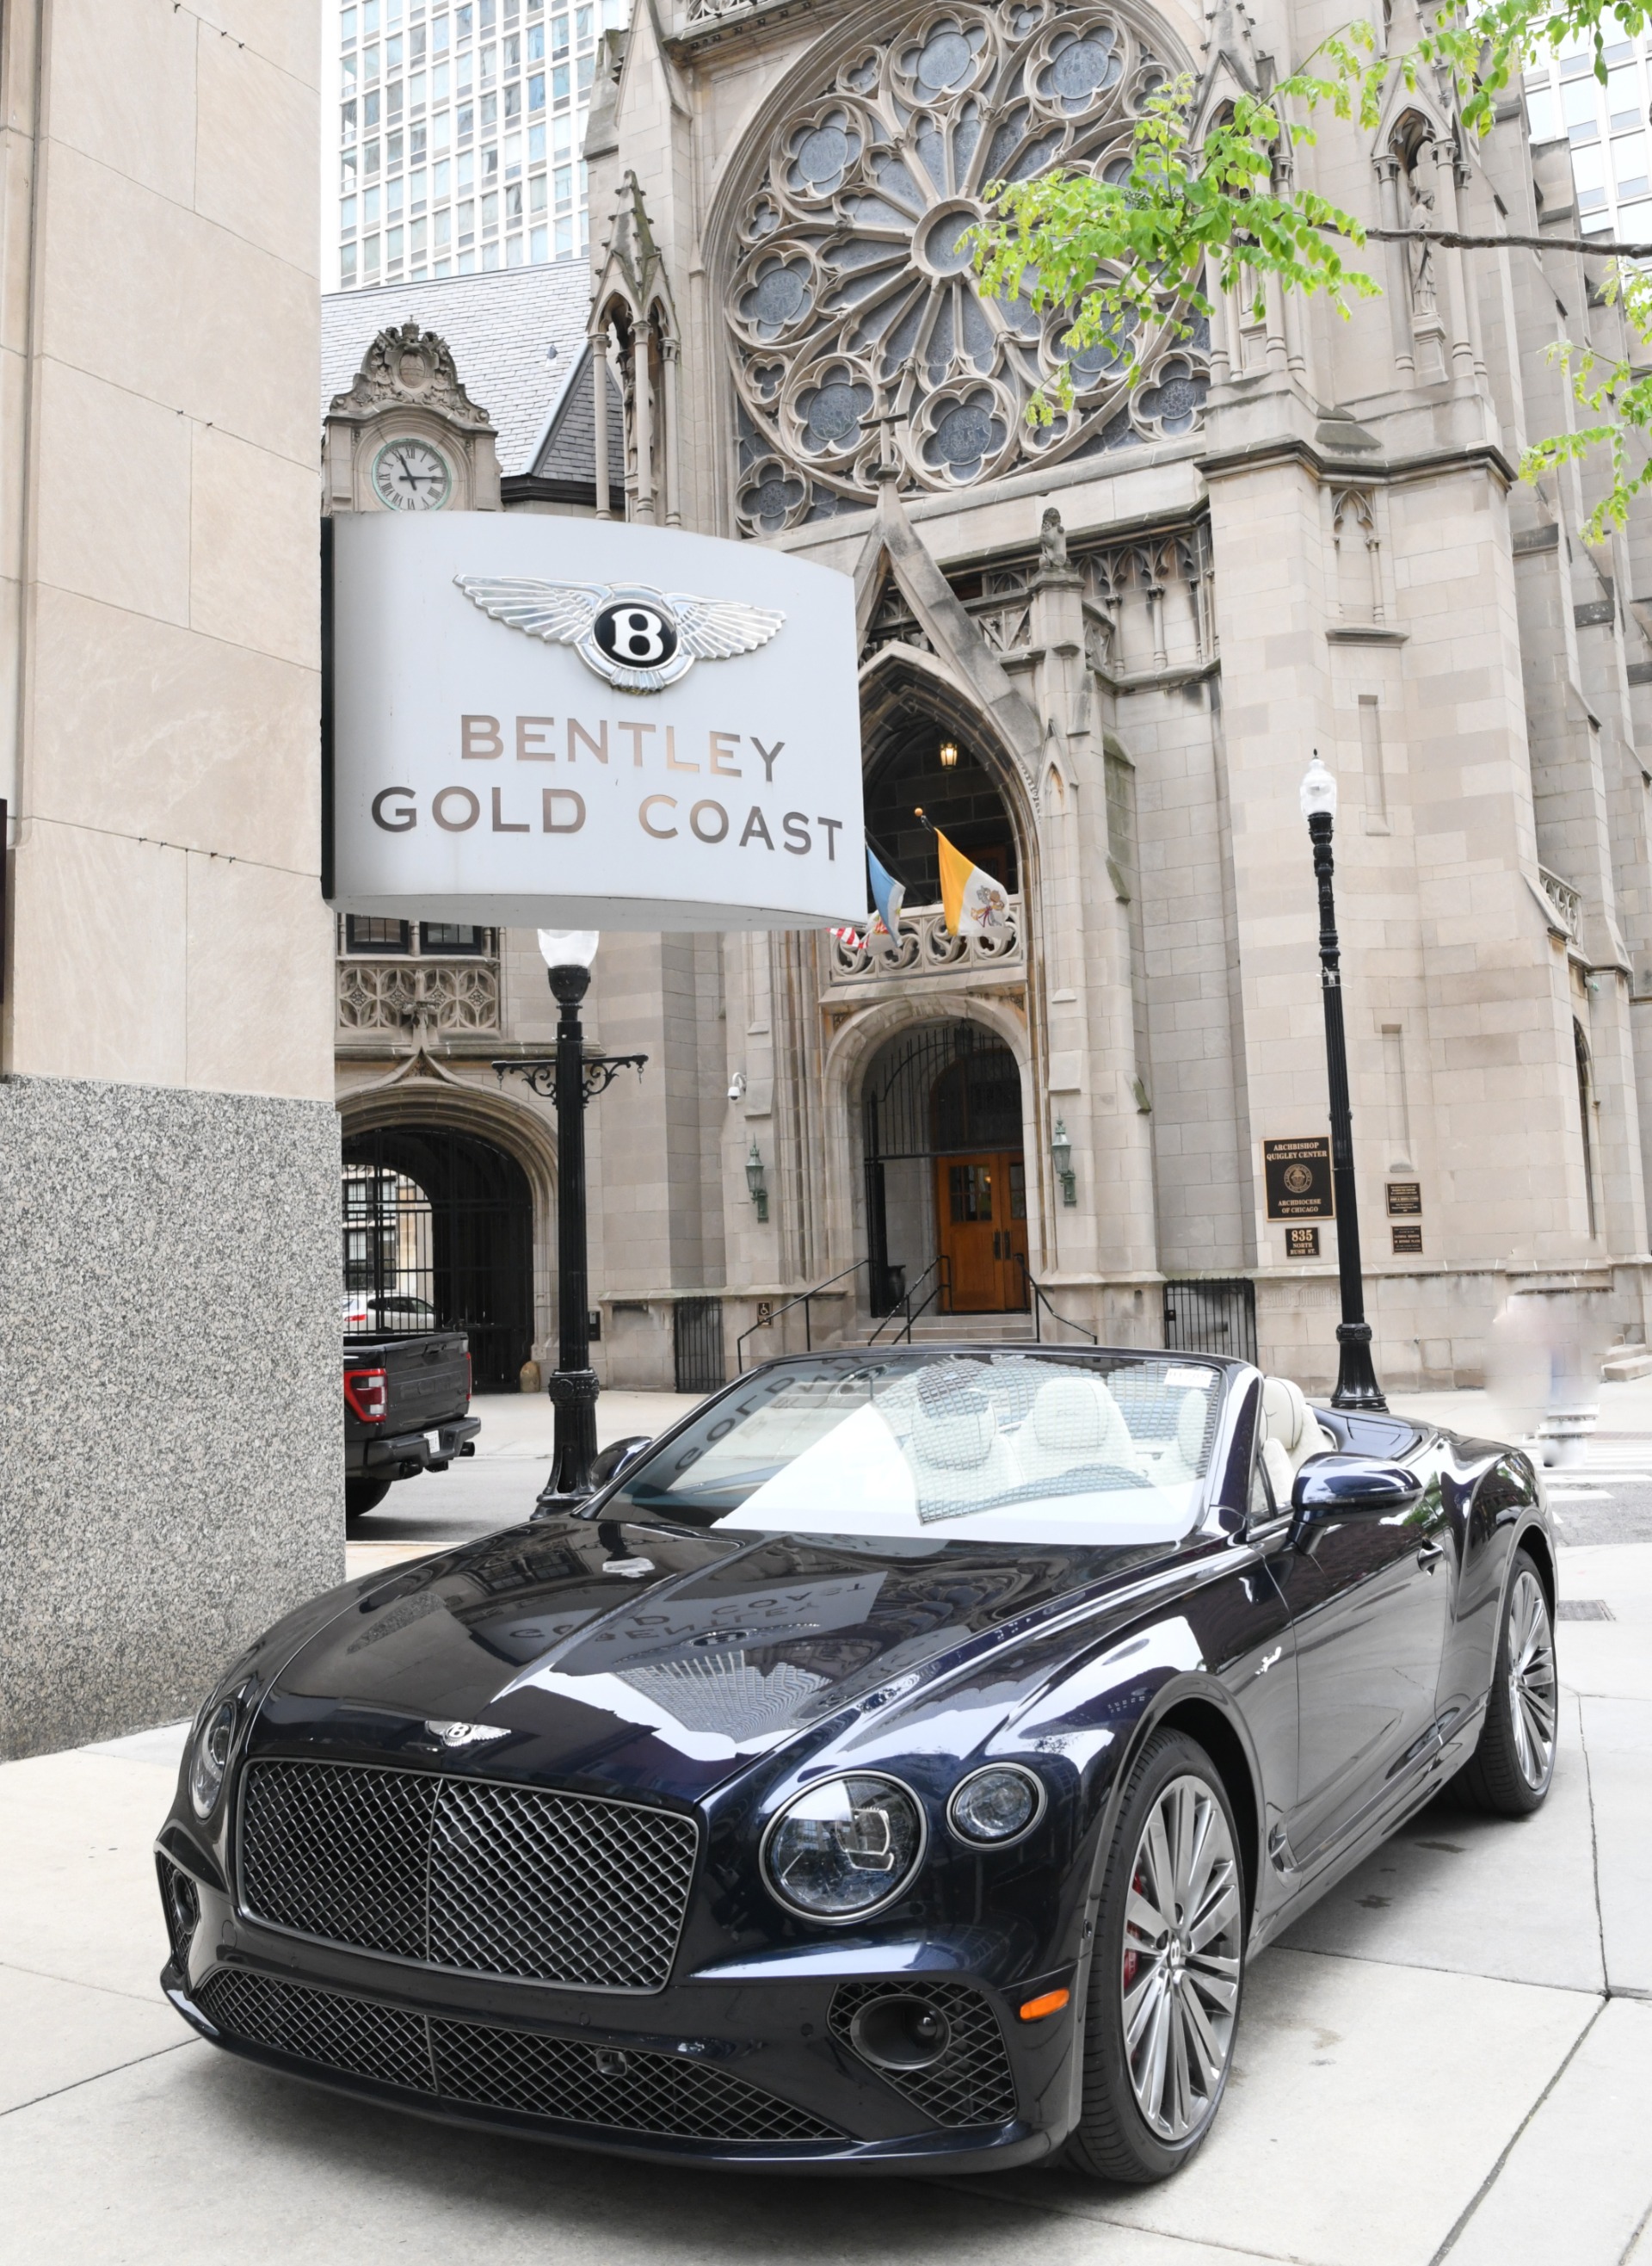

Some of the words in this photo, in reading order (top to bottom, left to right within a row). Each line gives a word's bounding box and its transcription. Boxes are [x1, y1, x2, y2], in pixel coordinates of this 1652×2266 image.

[611, 608, 663, 662] B
[461, 714, 786, 782] BENTLEY
[371, 787, 586, 834] GOLD
[638, 794, 842, 861] COAST
[1273, 1141, 1320, 1152] ARCHBISHOP
[1267, 1152, 1298, 1162] QUIGLEY
[1298, 1150, 1328, 1158] CENTER
[1278, 1198, 1322, 1207] ARCHDIOCESE
[1291, 1229, 1313, 1242] 835
